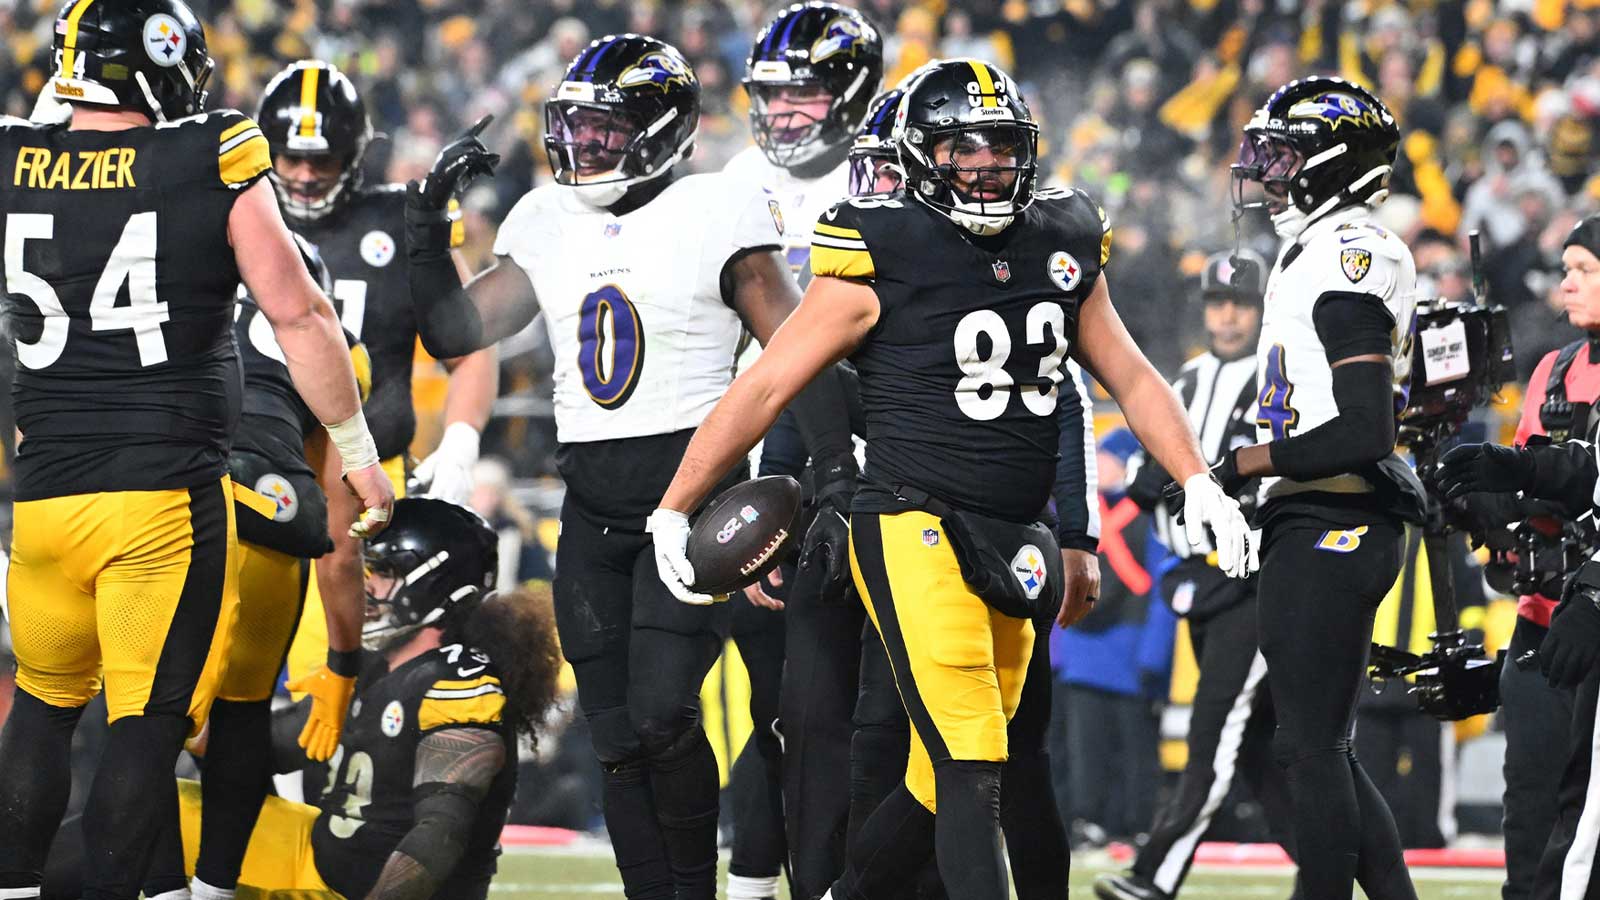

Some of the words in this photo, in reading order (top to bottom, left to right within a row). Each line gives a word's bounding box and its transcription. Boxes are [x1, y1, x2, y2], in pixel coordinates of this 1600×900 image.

[54, 49, 86, 80] 54
[54, 81, 85, 97] Steelers
[966, 81, 1009, 108] 83
[980, 108, 1005, 117] Steelers
[13, 145, 137, 190] FRAZIER
[590, 267, 632, 279] RAVENS
[4, 211, 171, 370] 54
[577, 282, 646, 411] 0
[953, 301, 1069, 421] 83
[1015, 566, 1032, 575] Steelers
